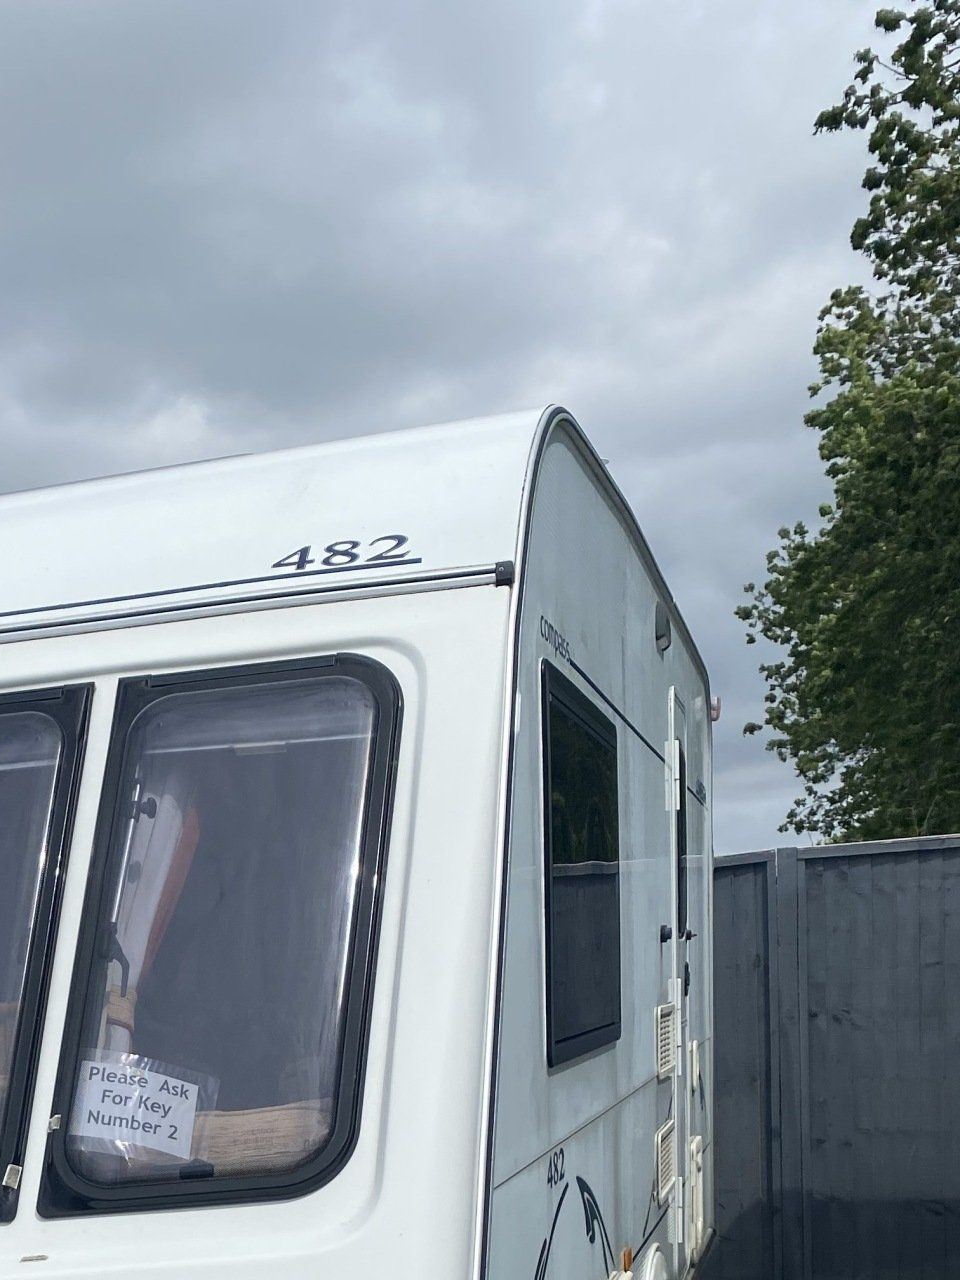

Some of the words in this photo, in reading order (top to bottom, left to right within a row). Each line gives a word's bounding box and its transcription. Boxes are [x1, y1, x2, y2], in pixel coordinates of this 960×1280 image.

[271, 534, 411, 570] 482
[540, 615, 570, 662] compass
[88, 1066, 149, 1088] Please
[159, 1079, 190, 1100] Ask
[101, 1089, 132, 1107] For
[138, 1095, 173, 1119] Key
[87, 1109, 162, 1135] Number
[167, 1124, 178, 1141] 2
[547, 1147, 565, 1189] 482
